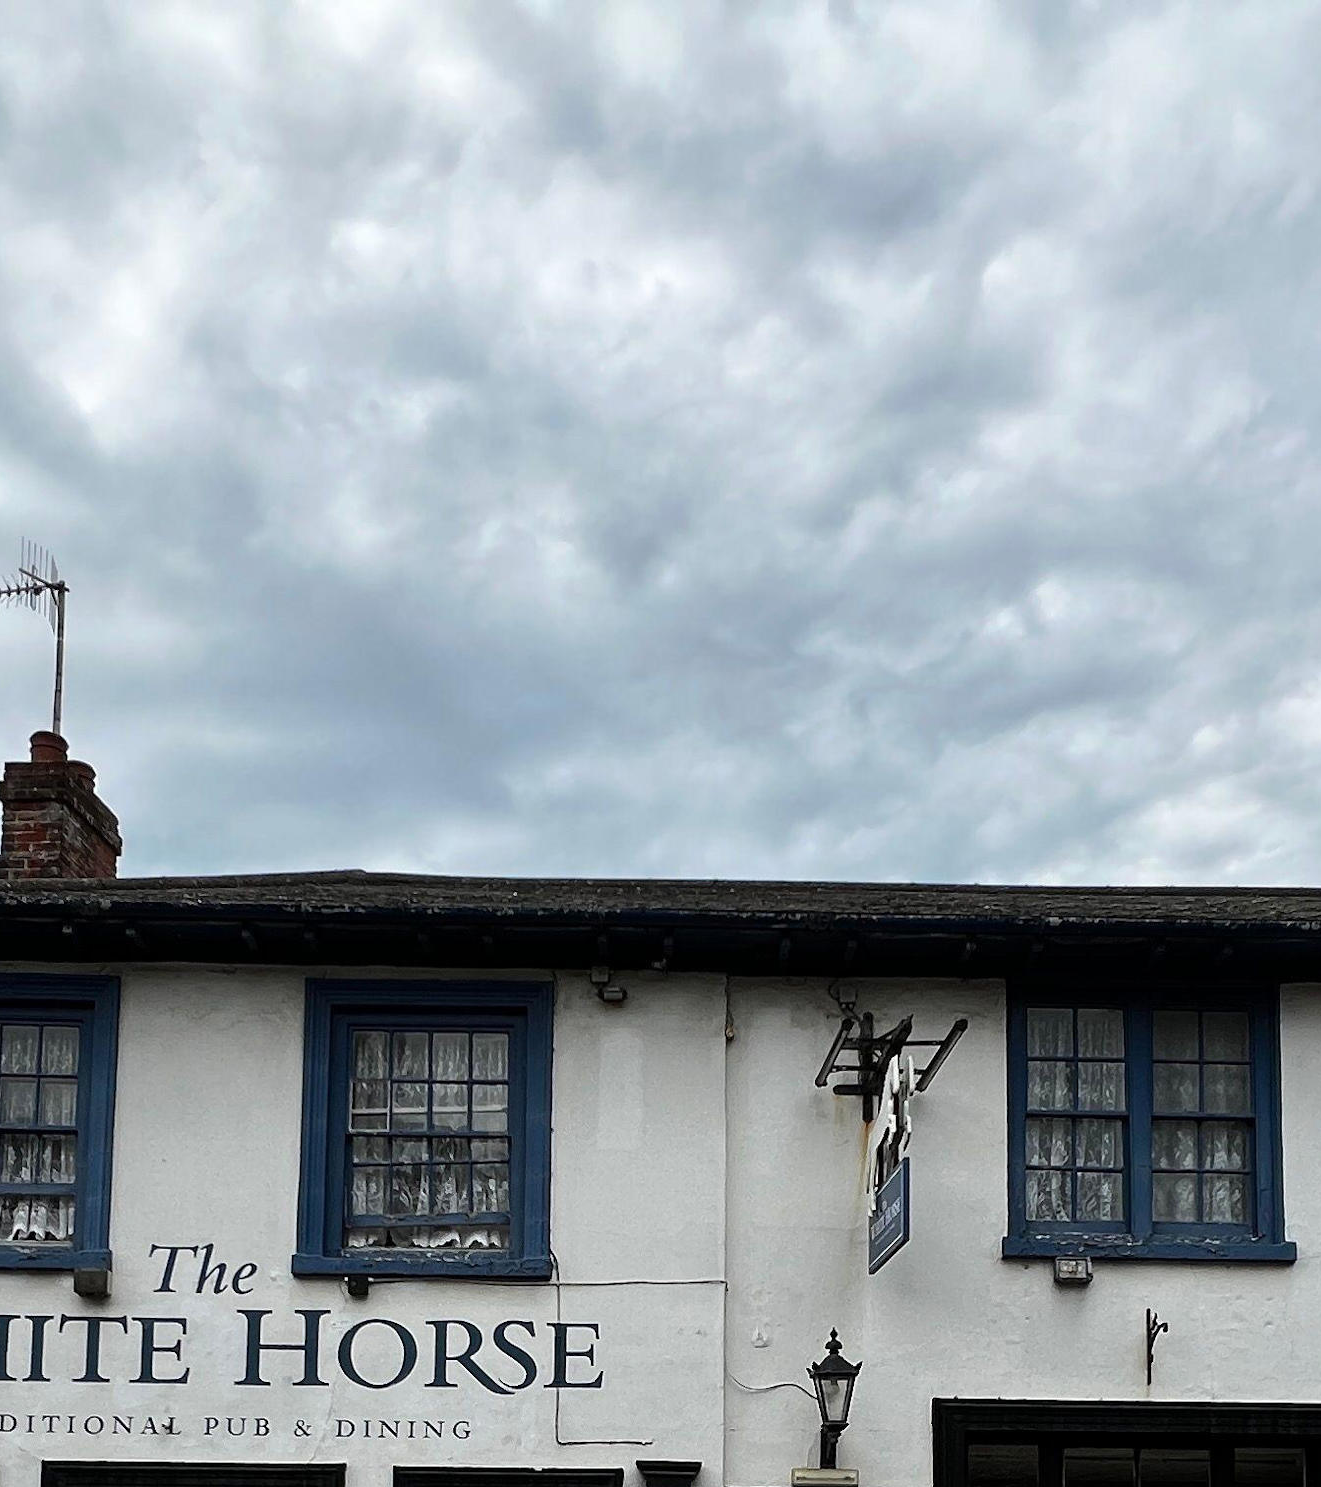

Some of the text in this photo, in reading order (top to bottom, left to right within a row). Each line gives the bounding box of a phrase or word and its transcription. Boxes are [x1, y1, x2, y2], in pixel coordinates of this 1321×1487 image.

[149, 1243, 258, 1295] The
[234, 1308, 604, 1395] HORSE
[204, 1416, 271, 1437] PUB
[293, 1419, 312, 1438] &
[335, 1418, 472, 1441] DINING
